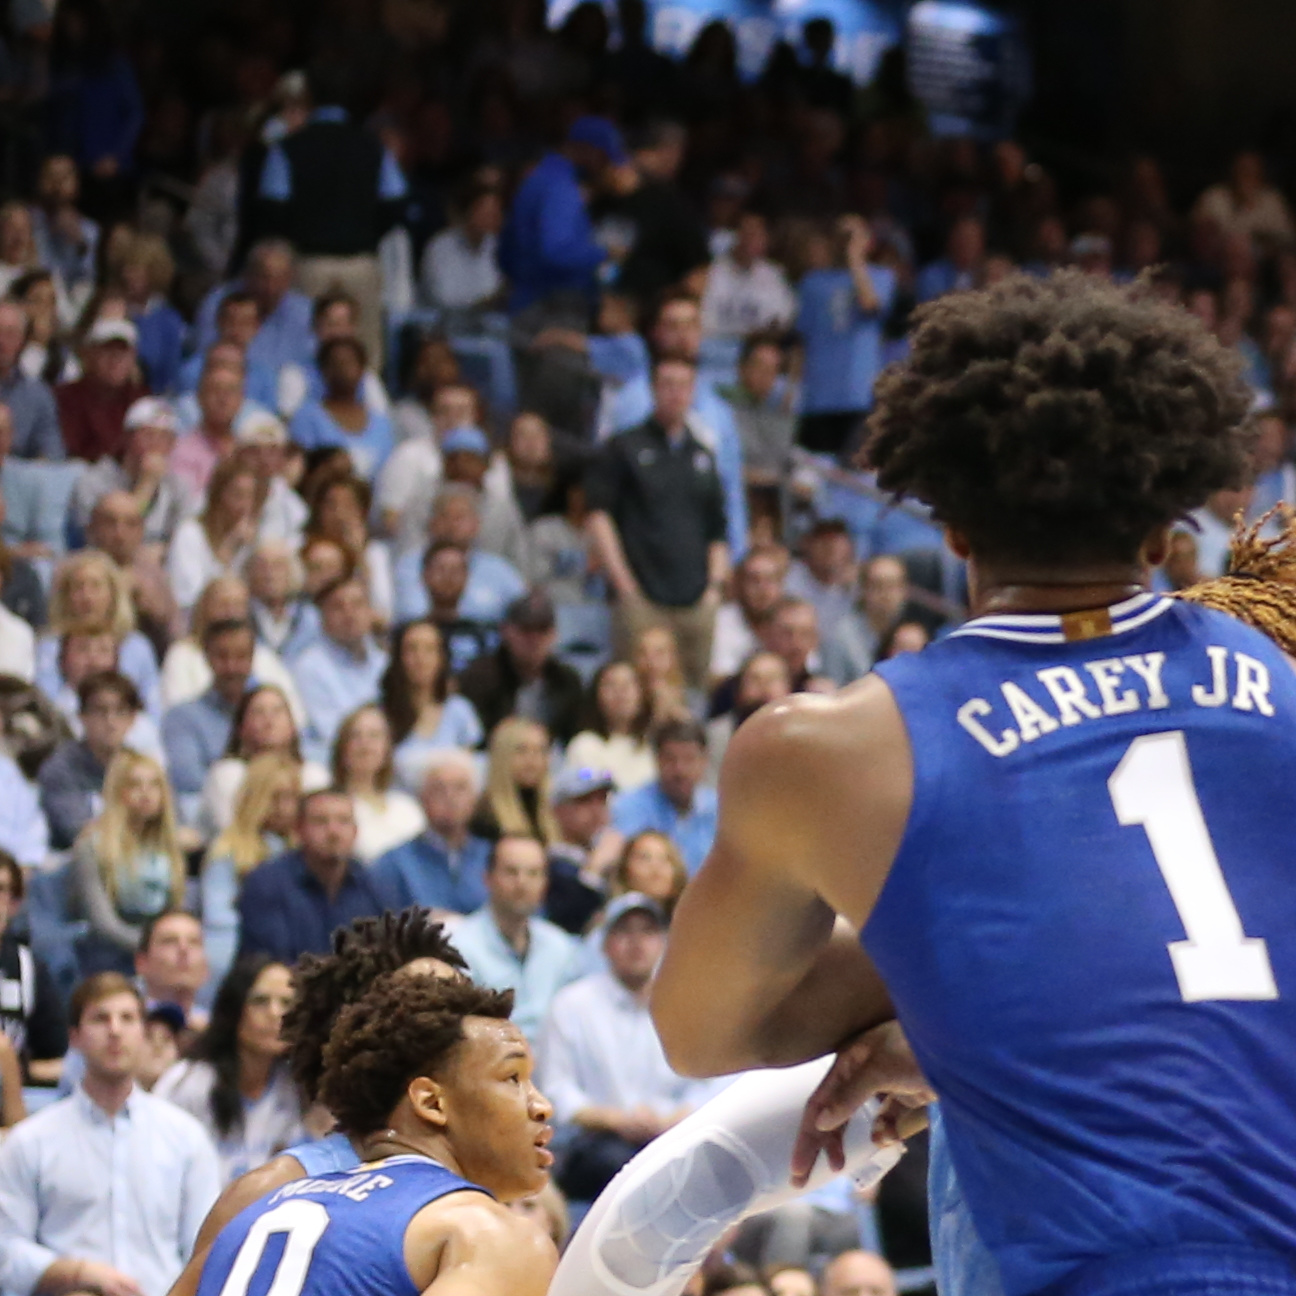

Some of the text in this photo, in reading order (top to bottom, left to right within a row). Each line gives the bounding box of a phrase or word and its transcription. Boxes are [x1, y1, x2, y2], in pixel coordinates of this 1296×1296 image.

[956, 645, 1276, 757] CAREY JR
[1106, 729, 1280, 1003] 1
